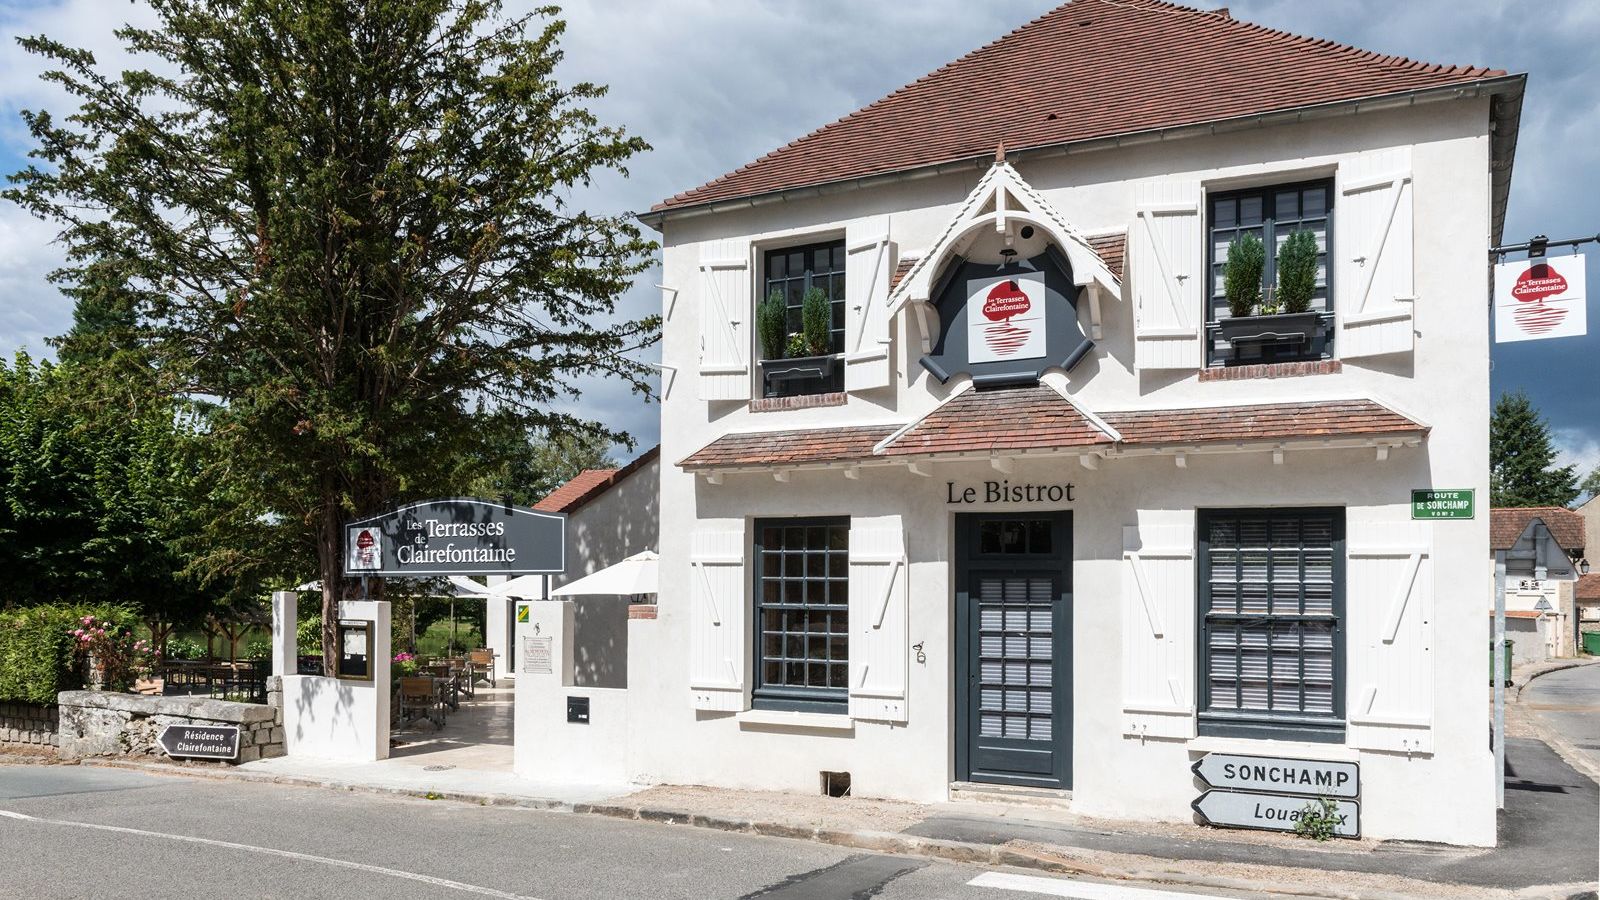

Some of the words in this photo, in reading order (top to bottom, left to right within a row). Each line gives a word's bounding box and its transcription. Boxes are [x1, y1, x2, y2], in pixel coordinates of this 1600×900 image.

[1527, 278, 1561, 286] Terrasses
[1514, 284, 1566, 295] Clairefontaine
[995, 296, 1025, 304] Terrasses
[984, 303, 1029, 313] Clairefontaine
[946, 482, 976, 504] Le
[983, 480, 1075, 503] Bistrot
[1416, 502, 1425, 510] DE
[1426, 500, 1469, 510] SONCHAMP
[407, 520, 423, 530] Les
[425, 519, 504, 538] Terrasses
[414, 533, 426, 544] de
[397, 543, 516, 564] Clairefontaine
[184, 730, 224, 741] Résidence
[177, 742, 232, 753] Clairefontaine
[1224, 763, 1349, 787] SONCHAMP
